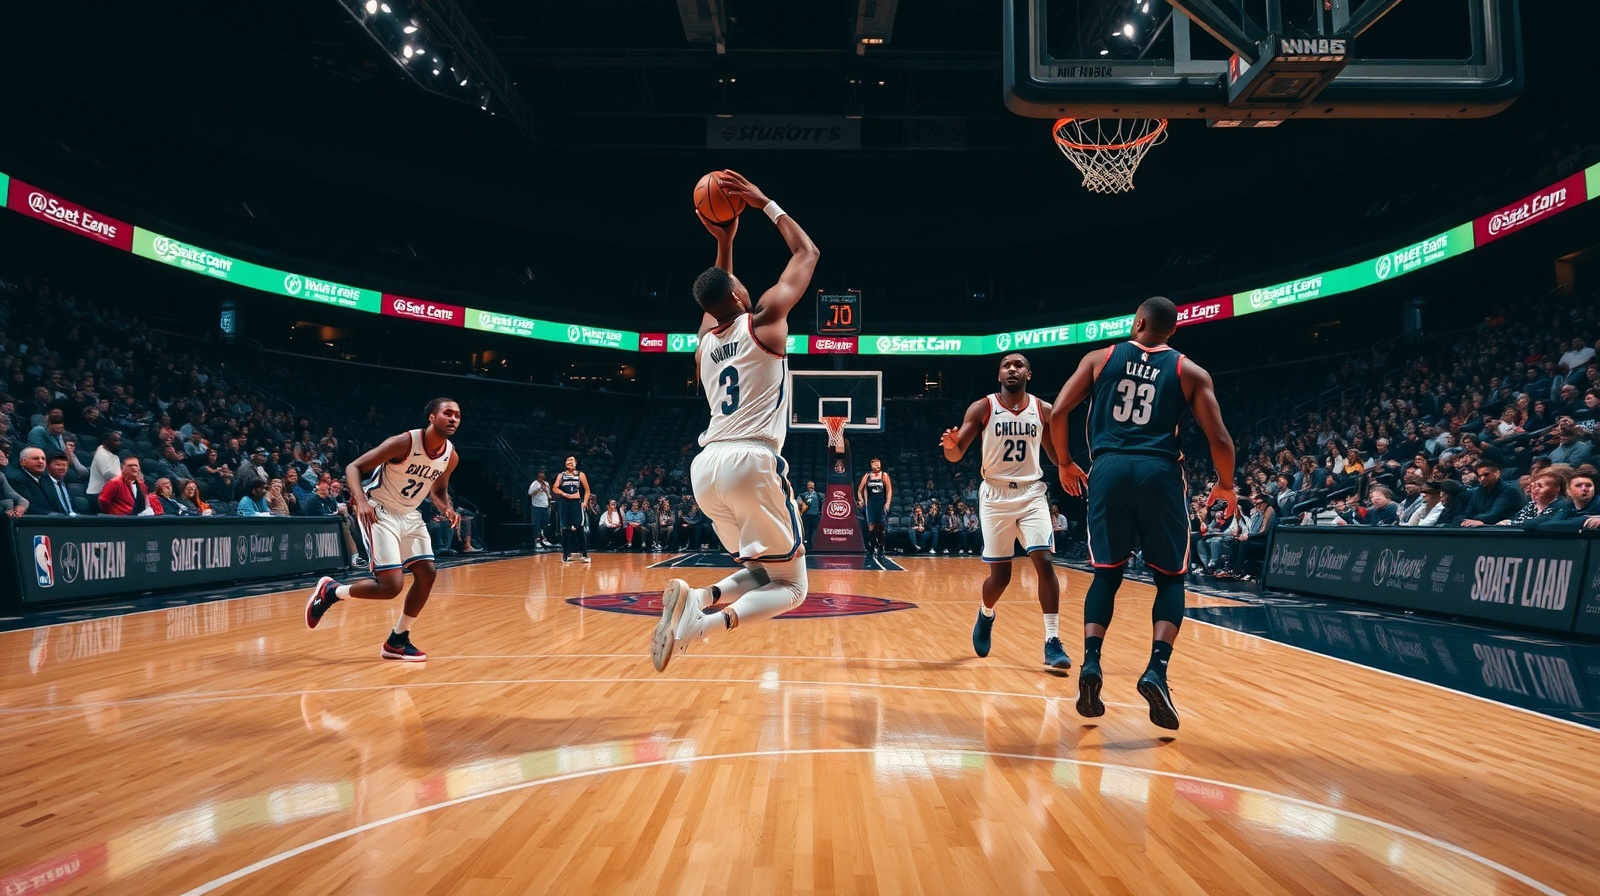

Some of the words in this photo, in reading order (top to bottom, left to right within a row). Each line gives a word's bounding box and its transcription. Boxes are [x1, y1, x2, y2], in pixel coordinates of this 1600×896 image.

[718, 365, 740, 415] 3
[1112, 378, 1156, 425] 33
[1002, 438, 1027, 463] 29
